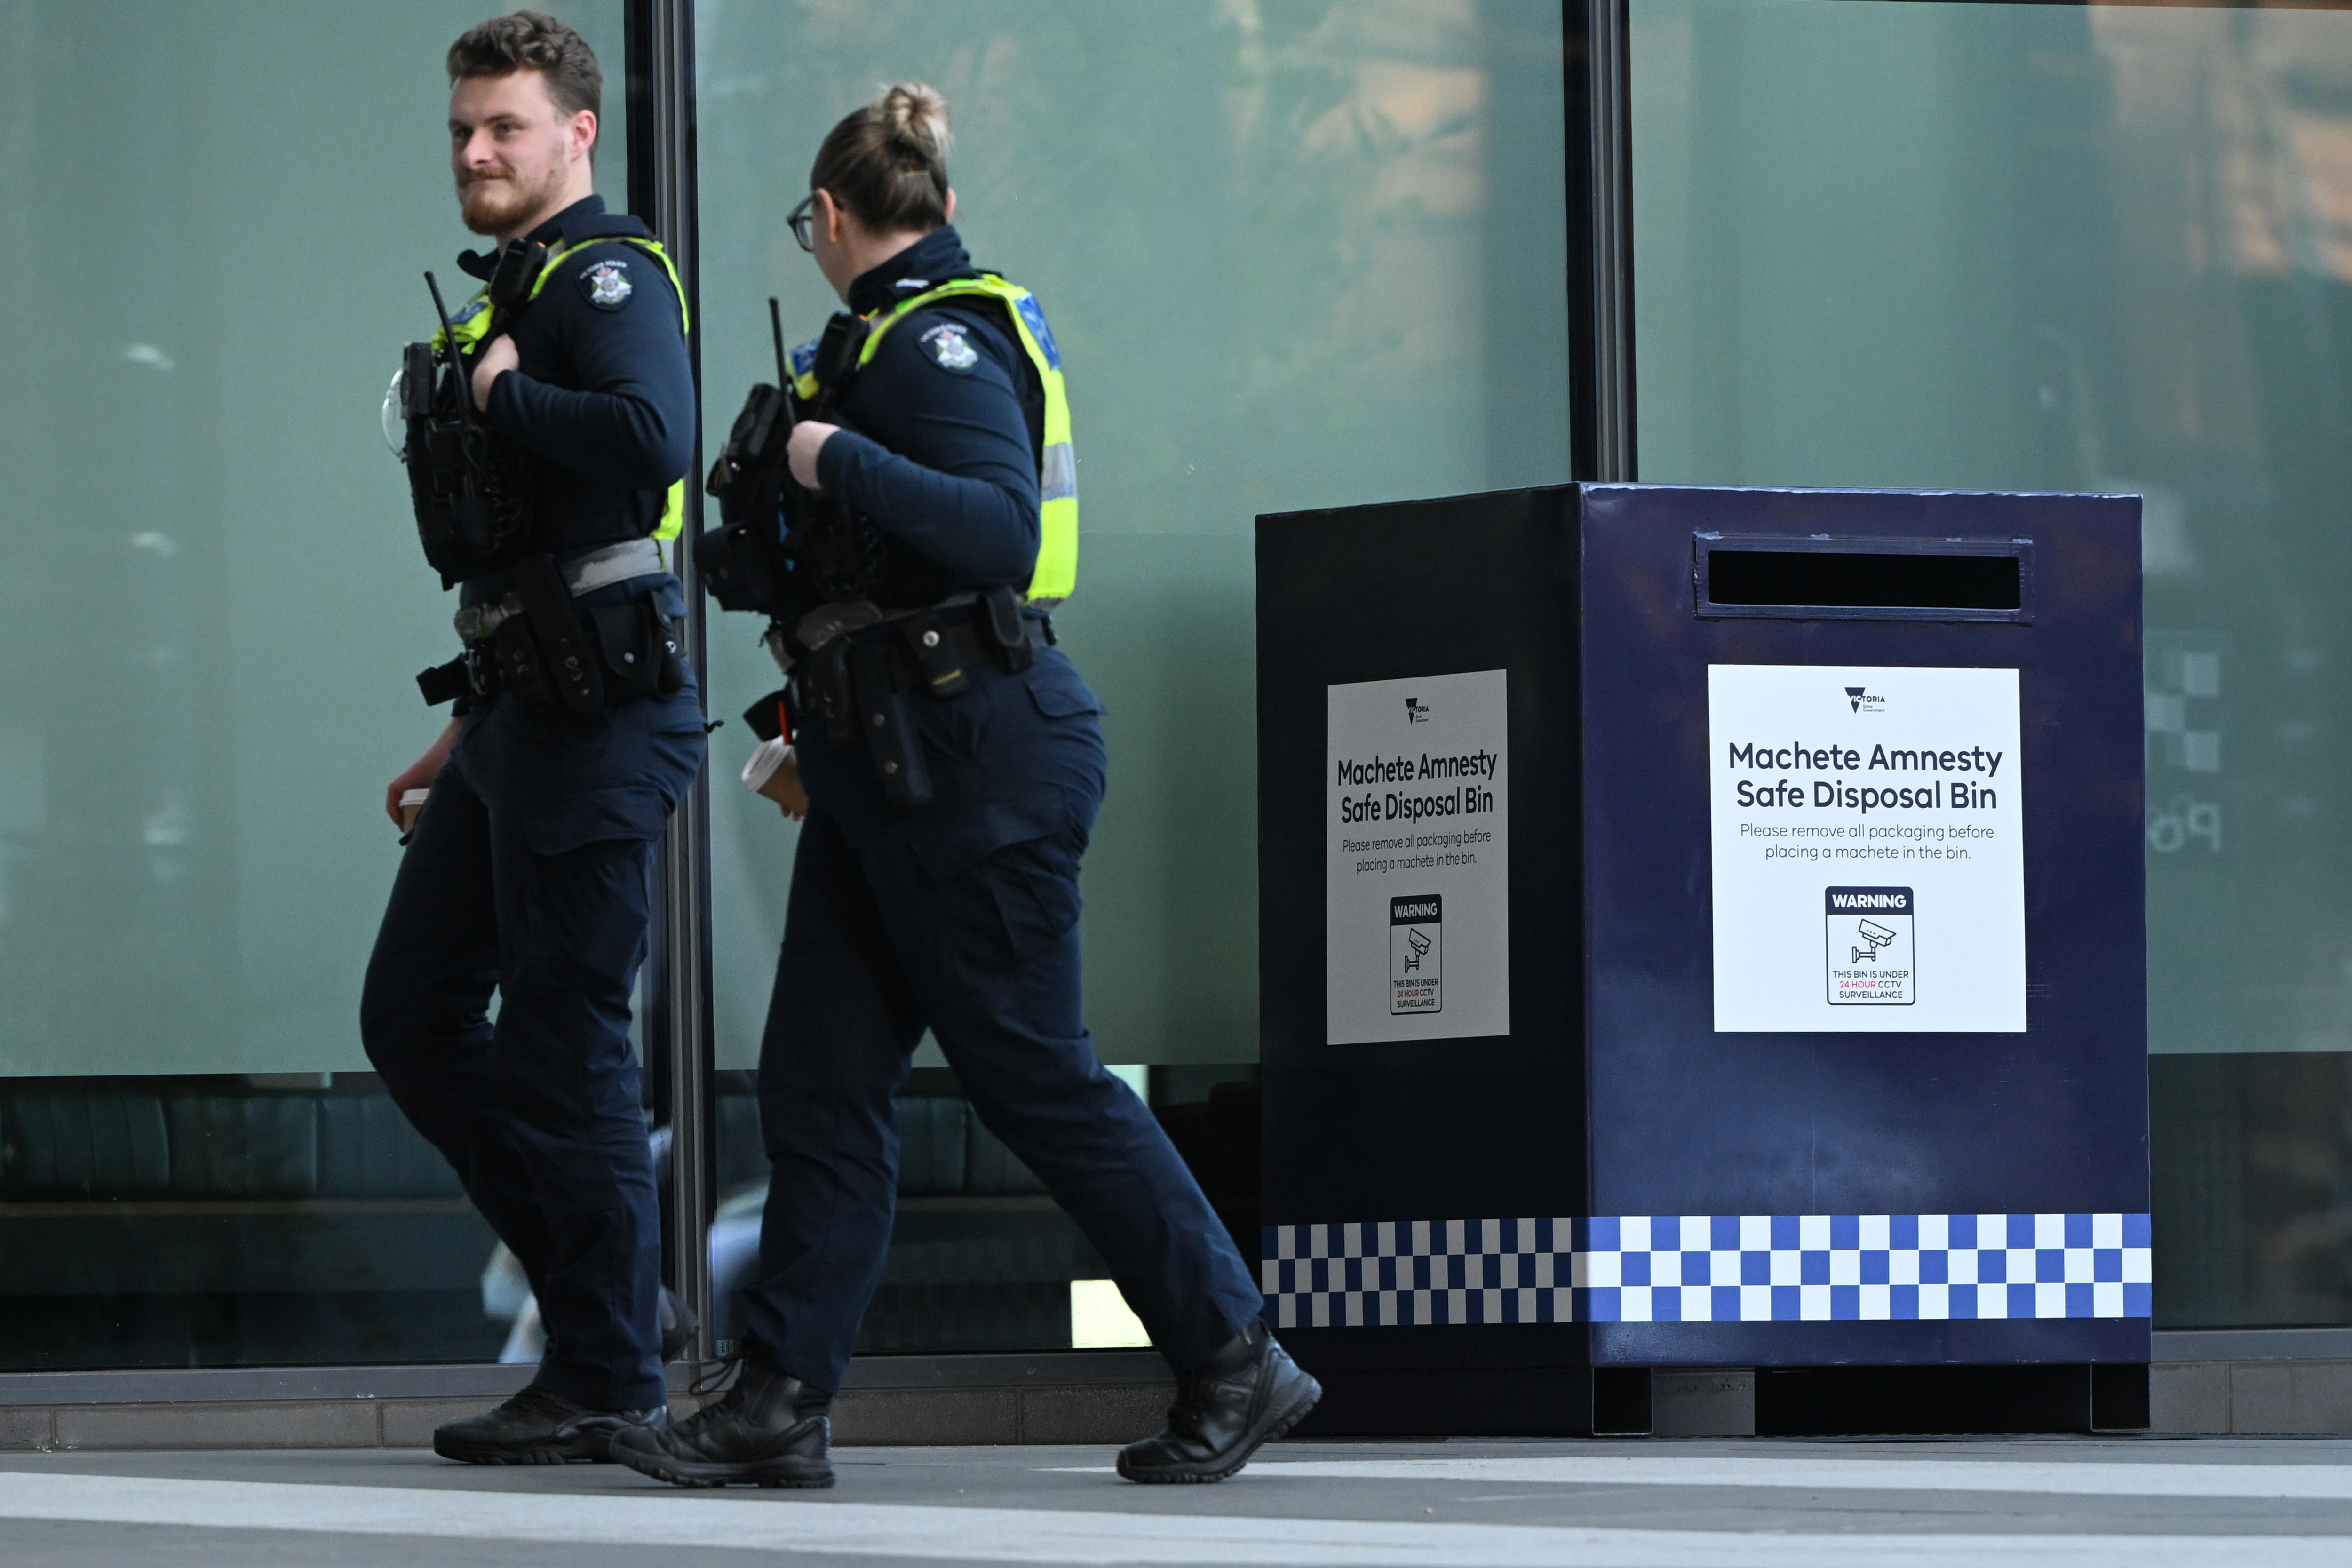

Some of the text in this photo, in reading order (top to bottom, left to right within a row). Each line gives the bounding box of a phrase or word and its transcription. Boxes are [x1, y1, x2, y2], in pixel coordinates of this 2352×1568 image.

[1338, 749, 1497, 786] Machete Amnesty
[1730, 741, 2002, 777] Machete Amnesty
[1342, 785, 1493, 824] Safe Disposal Bin
[1737, 779, 1996, 814] Safe Disposal Bin
[1343, 829, 1491, 852] Please remove all packaging before
[1741, 823, 1994, 841] Please remove all packaging before
[1357, 851, 1477, 875] placing a machete in the bin.
[1766, 844, 1971, 861] placing a machete in the bin.
[1394, 903, 1438, 918] WARNING
[1832, 895, 1906, 908] WARNING
[1398, 999, 1435, 1008] SURVEILLANCE
